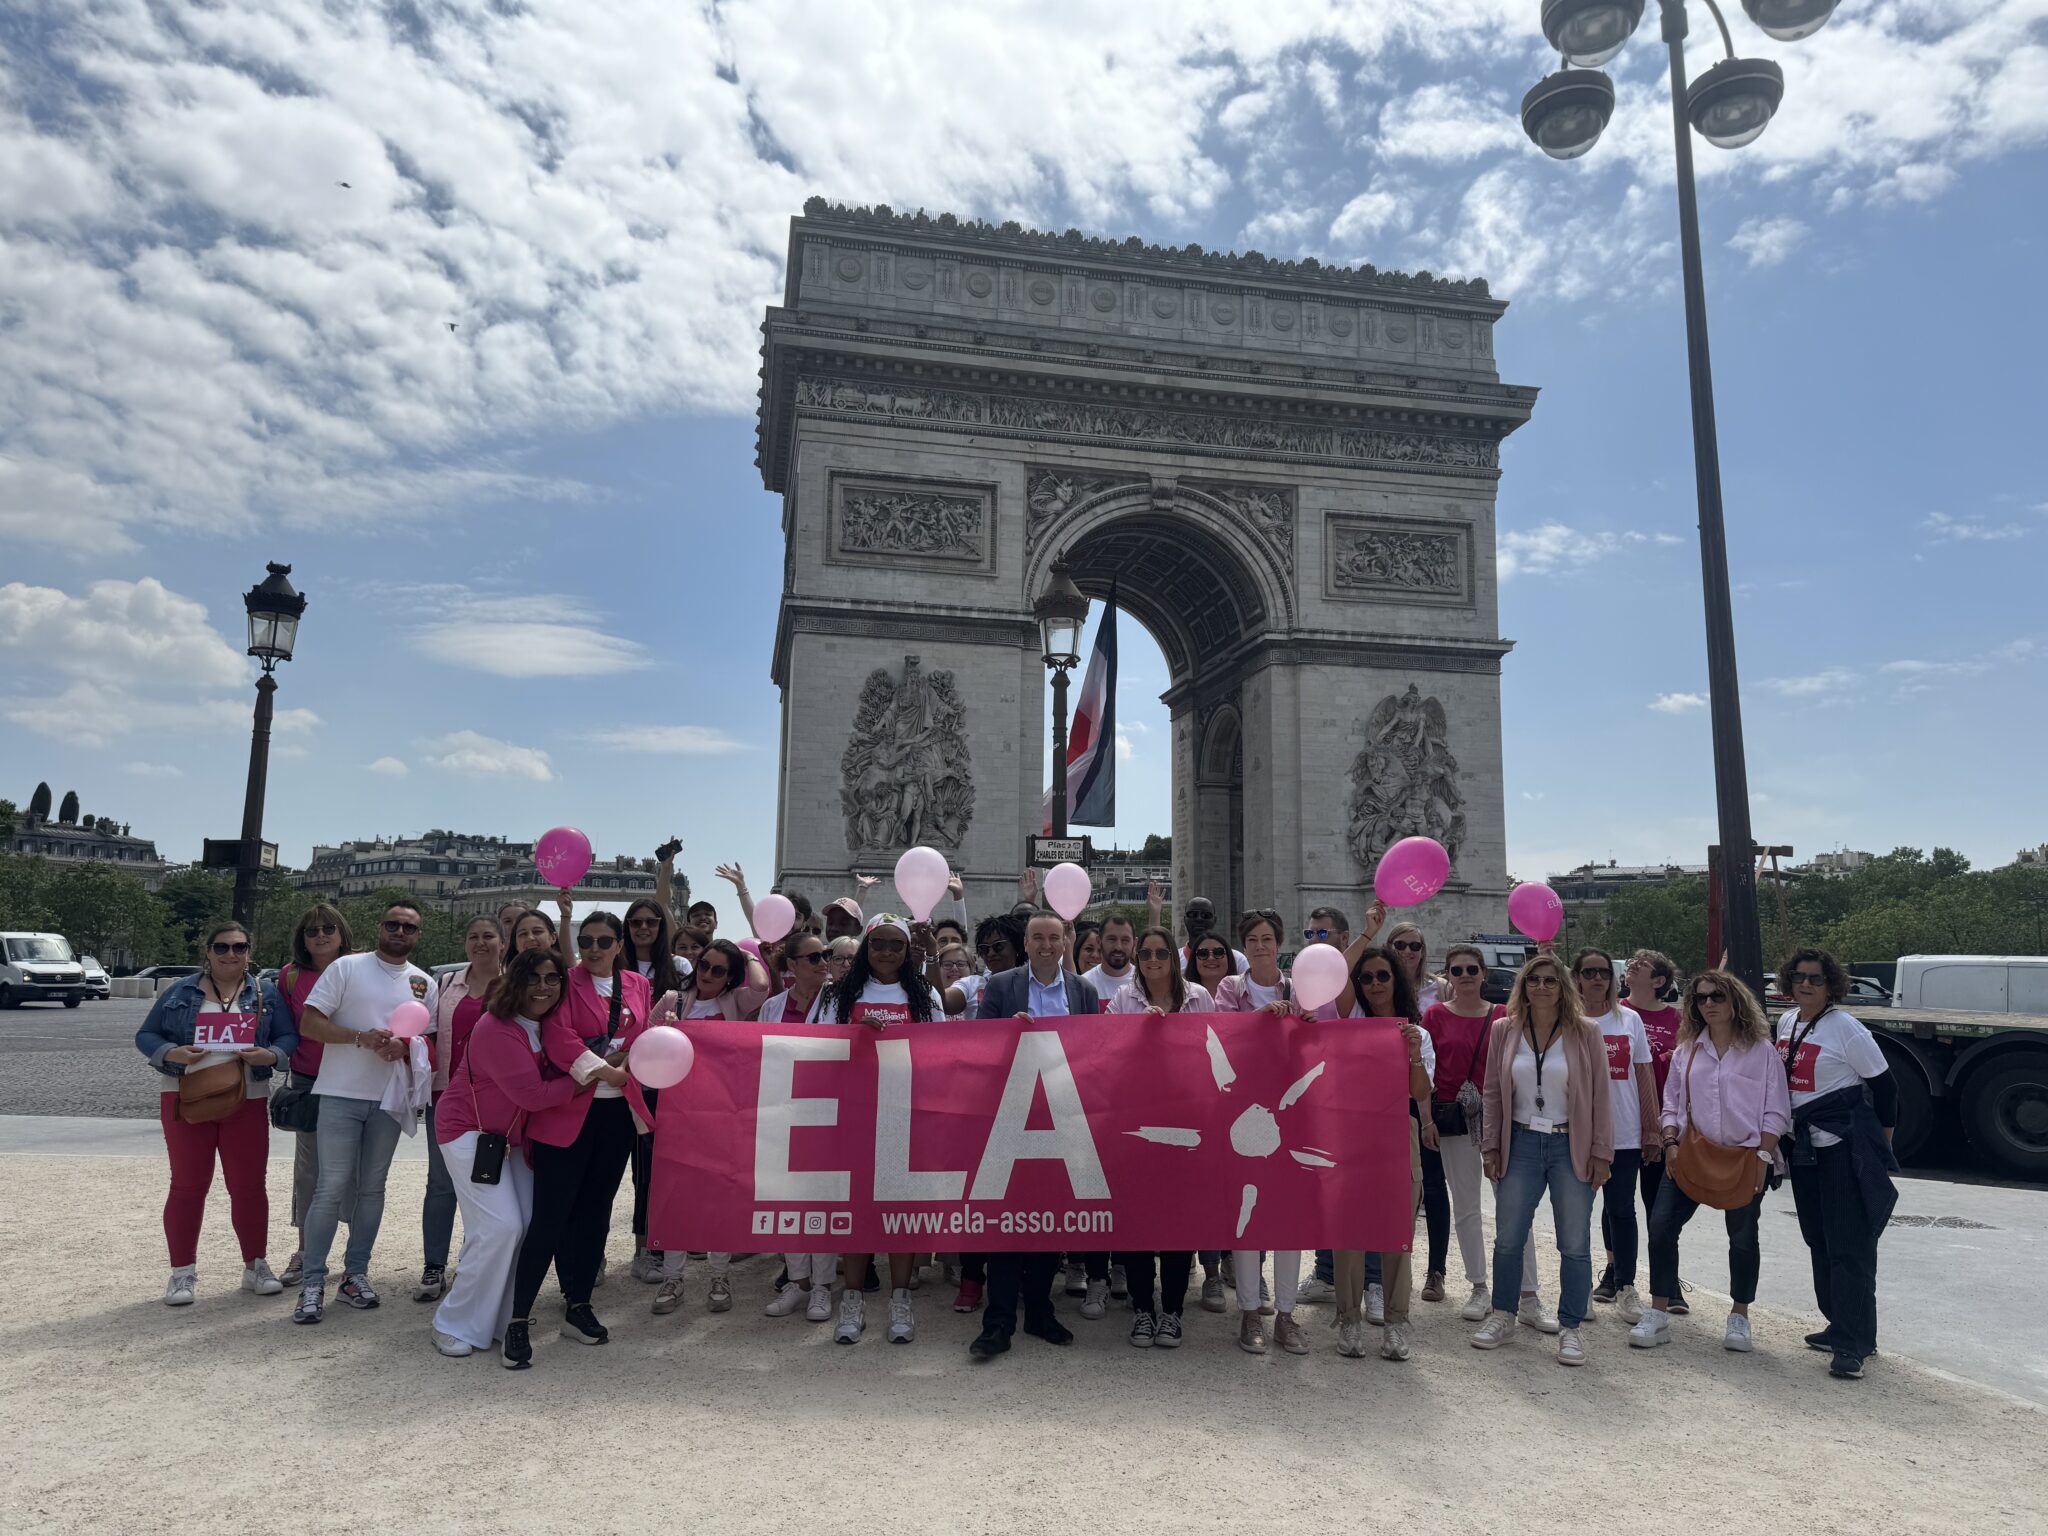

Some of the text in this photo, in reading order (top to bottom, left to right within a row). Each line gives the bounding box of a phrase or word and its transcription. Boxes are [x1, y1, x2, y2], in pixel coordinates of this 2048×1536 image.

[1047, 841, 1071, 849] Place
[538, 858, 554, 869] ELA
[1036, 850, 1083, 860] CHARLES DE GAULLE
[1403, 875, 1424, 896] ELA
[194, 1025, 235, 1044] ELA
[754, 1031, 1112, 1201] ELA
[881, 1203, 1113, 1234] www.ela-asso.com
